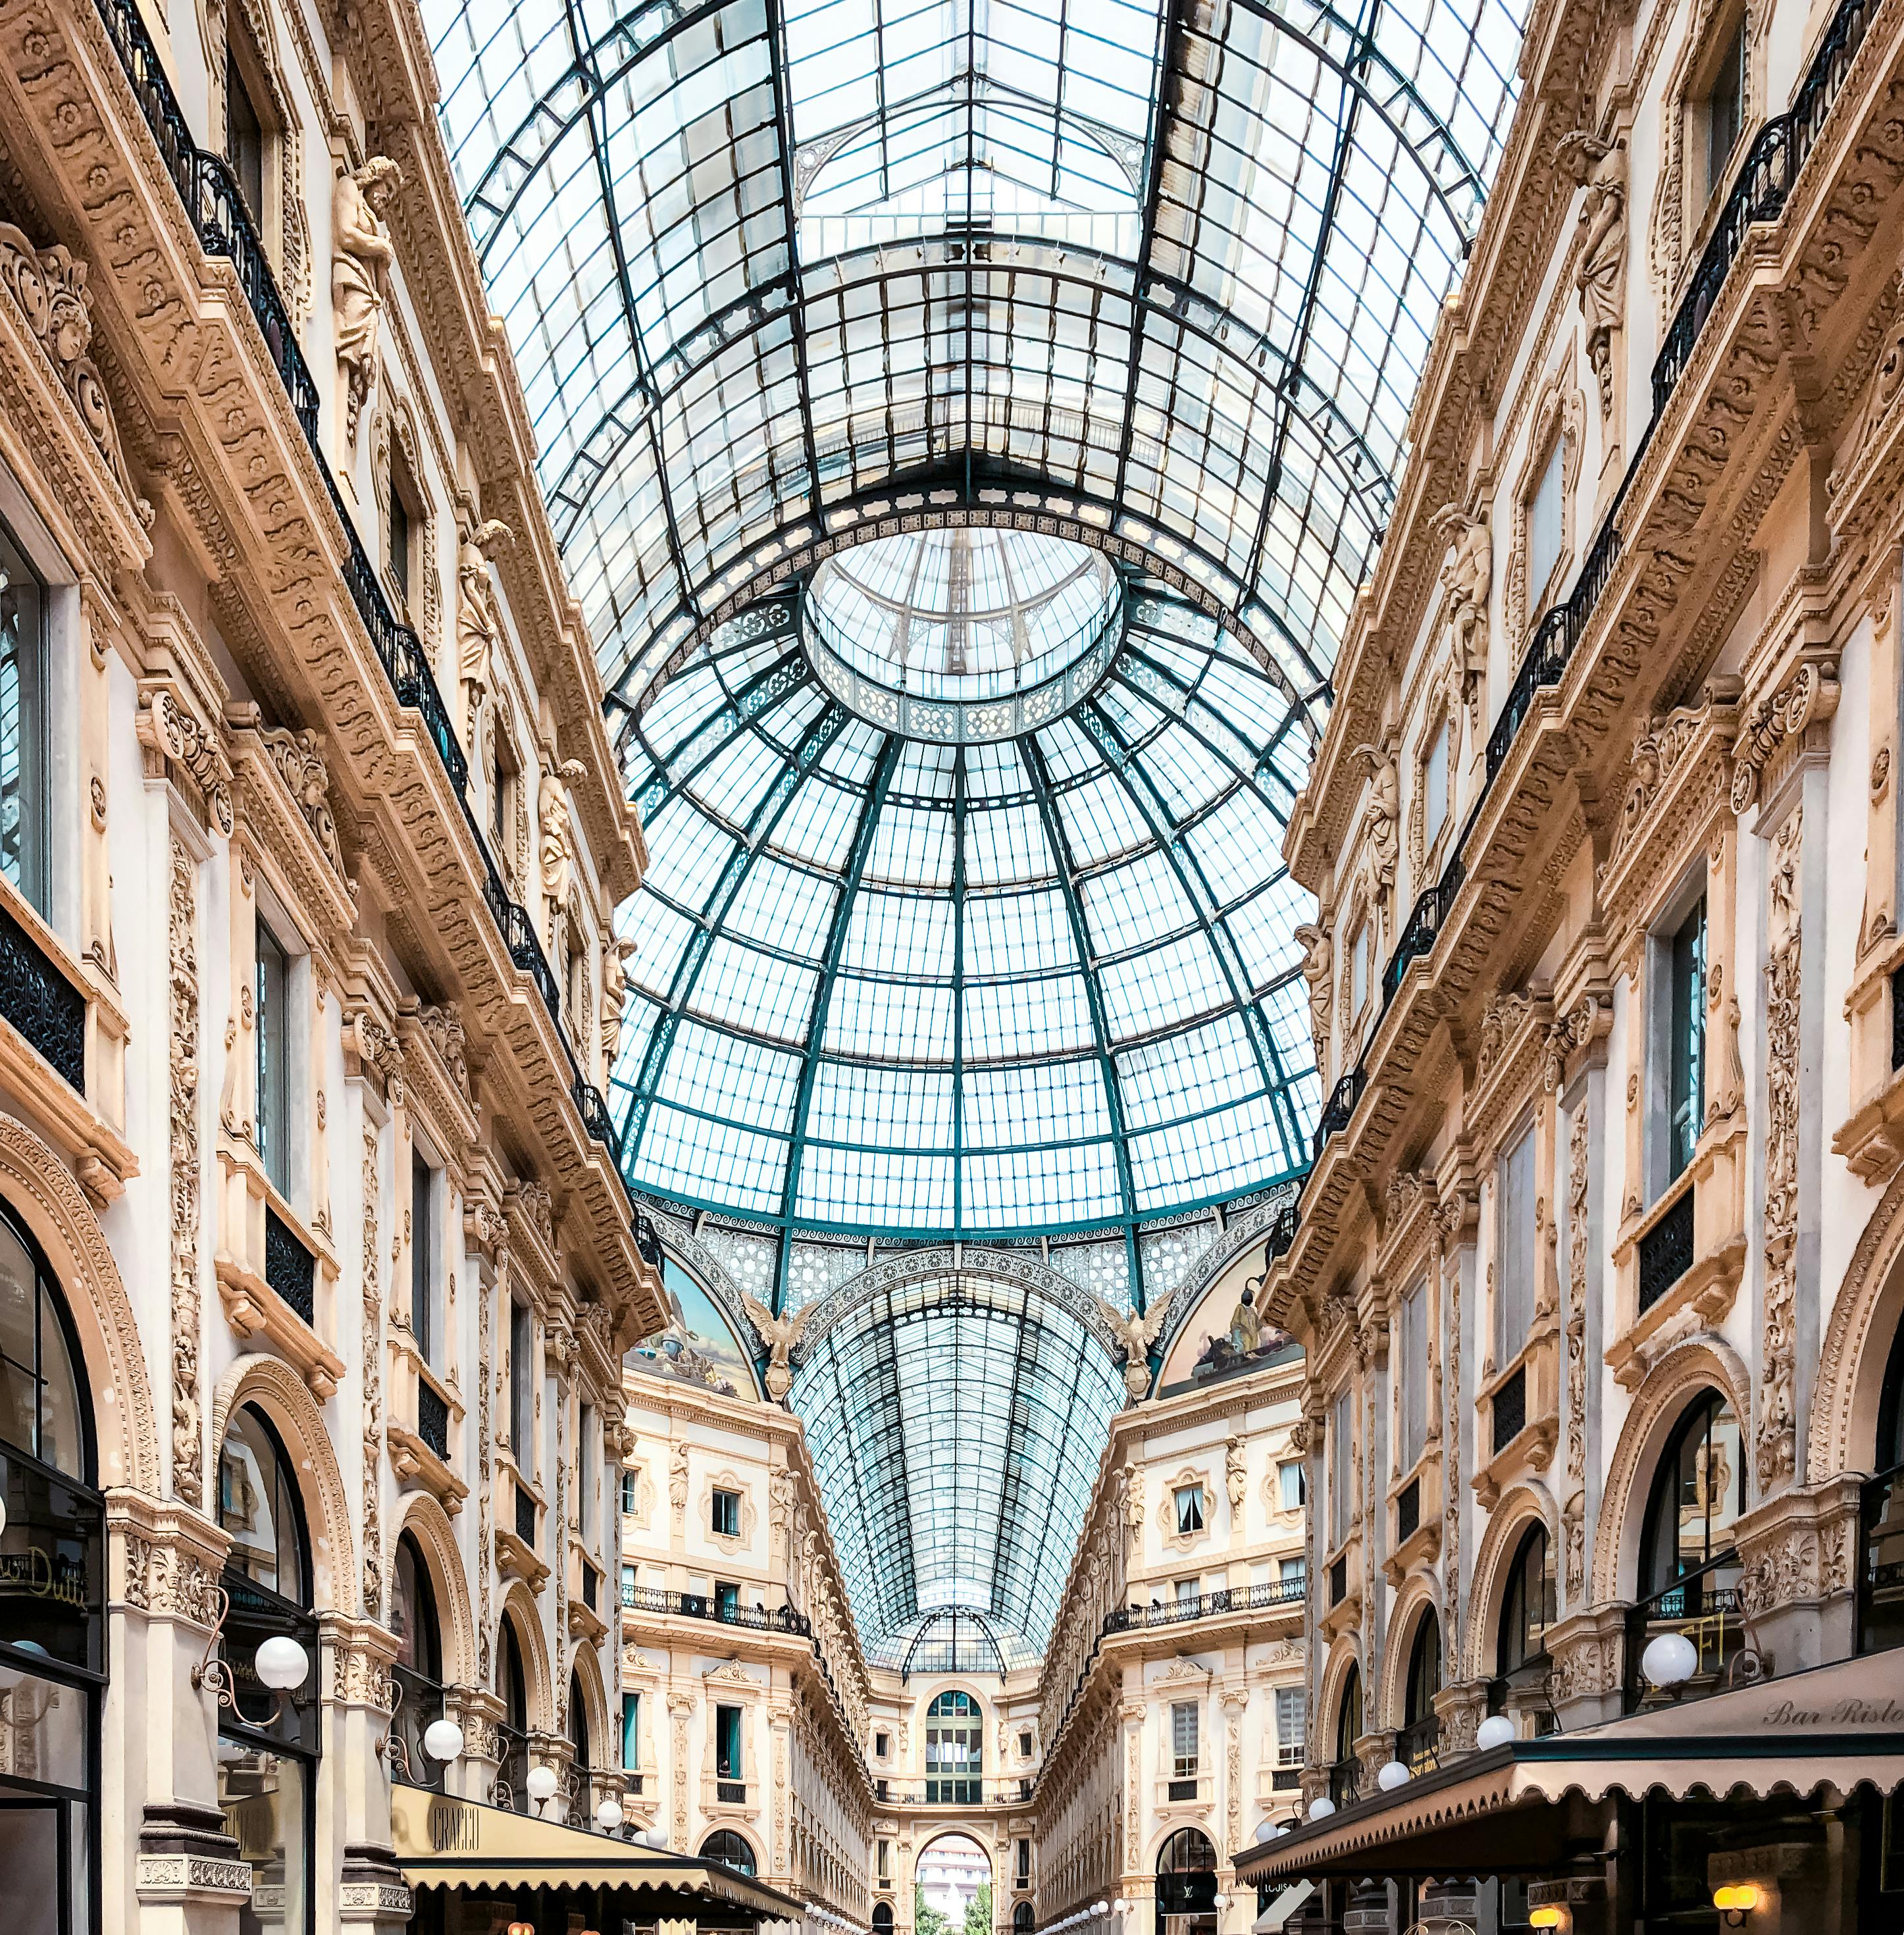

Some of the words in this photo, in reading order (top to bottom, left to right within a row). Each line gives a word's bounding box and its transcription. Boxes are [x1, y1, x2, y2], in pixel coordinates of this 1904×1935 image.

[1762, 1699, 1820, 1725] Bar
[434, 1807, 479, 1851] CRACCO
[1265, 1883, 1287, 1893] LOUIS
